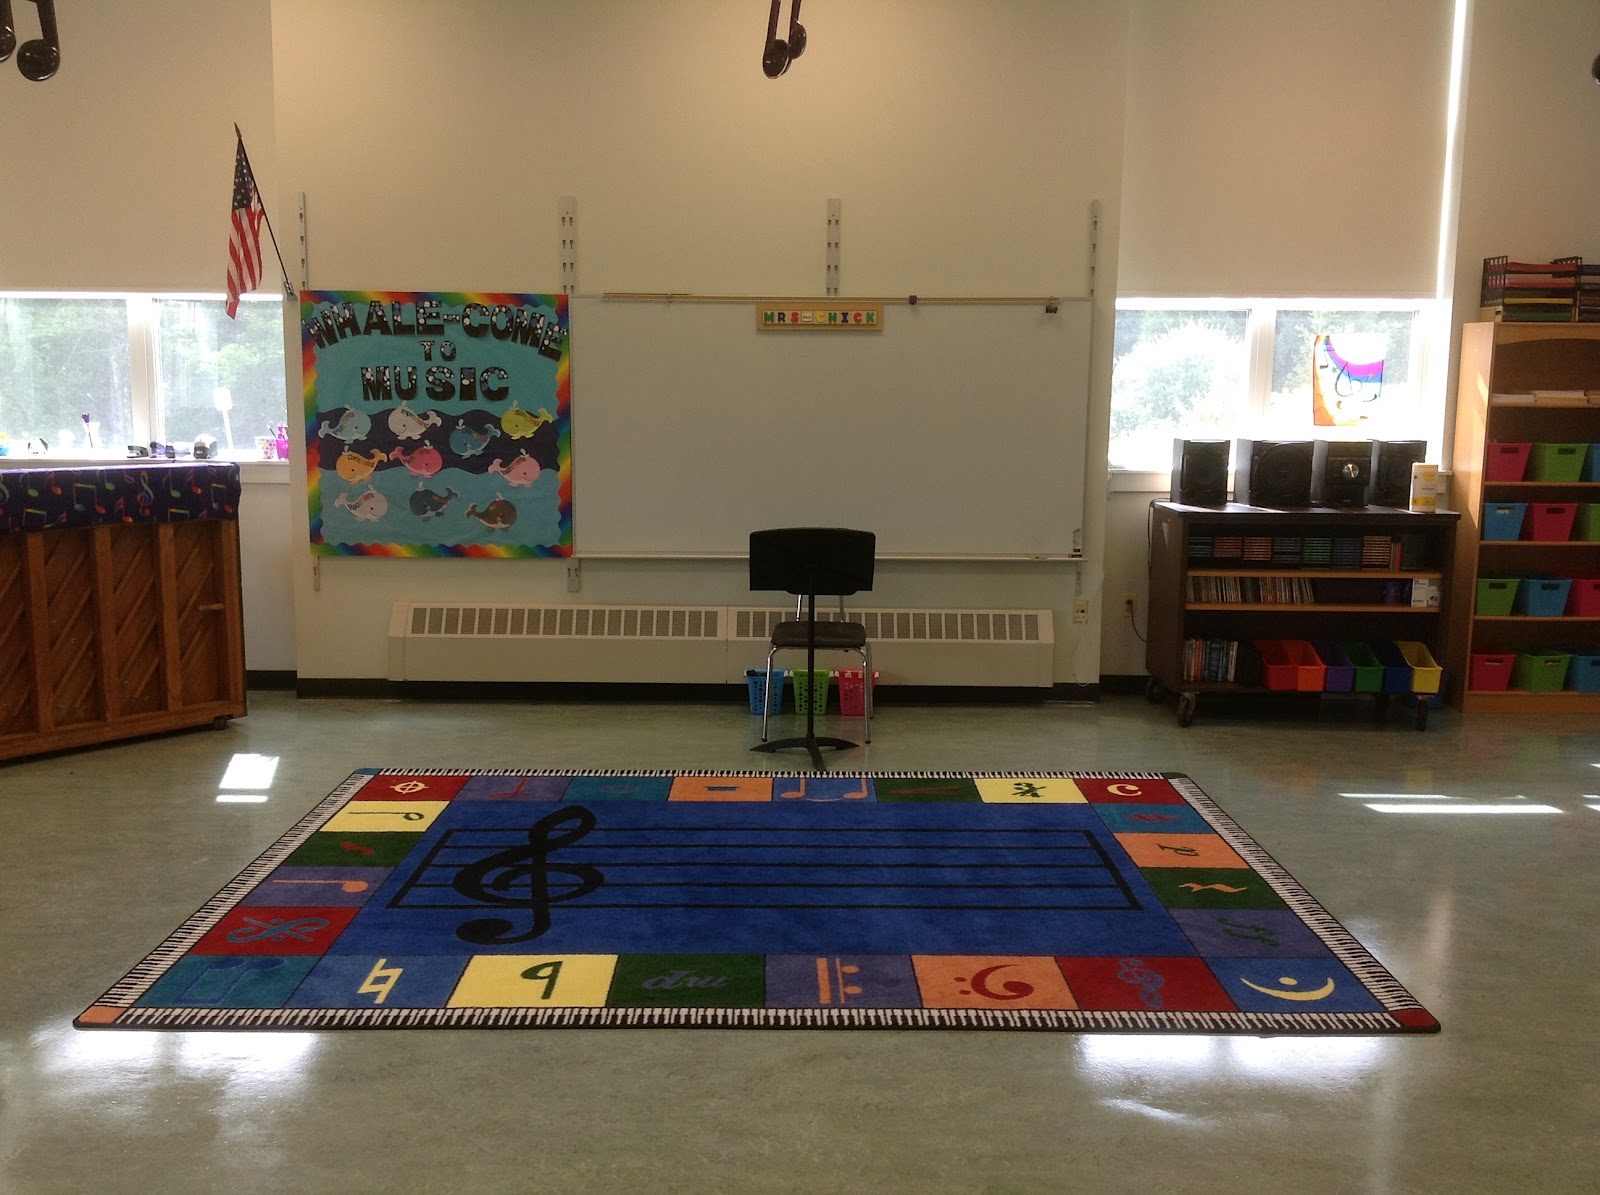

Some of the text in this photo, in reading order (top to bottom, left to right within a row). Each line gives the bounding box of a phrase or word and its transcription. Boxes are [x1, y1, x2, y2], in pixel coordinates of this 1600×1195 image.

[763, 311, 800, 323] MRS
[815, 311, 875, 323] CHICK
[419, 340, 457, 362] TO
[360, 366, 509, 401] MUSIC
